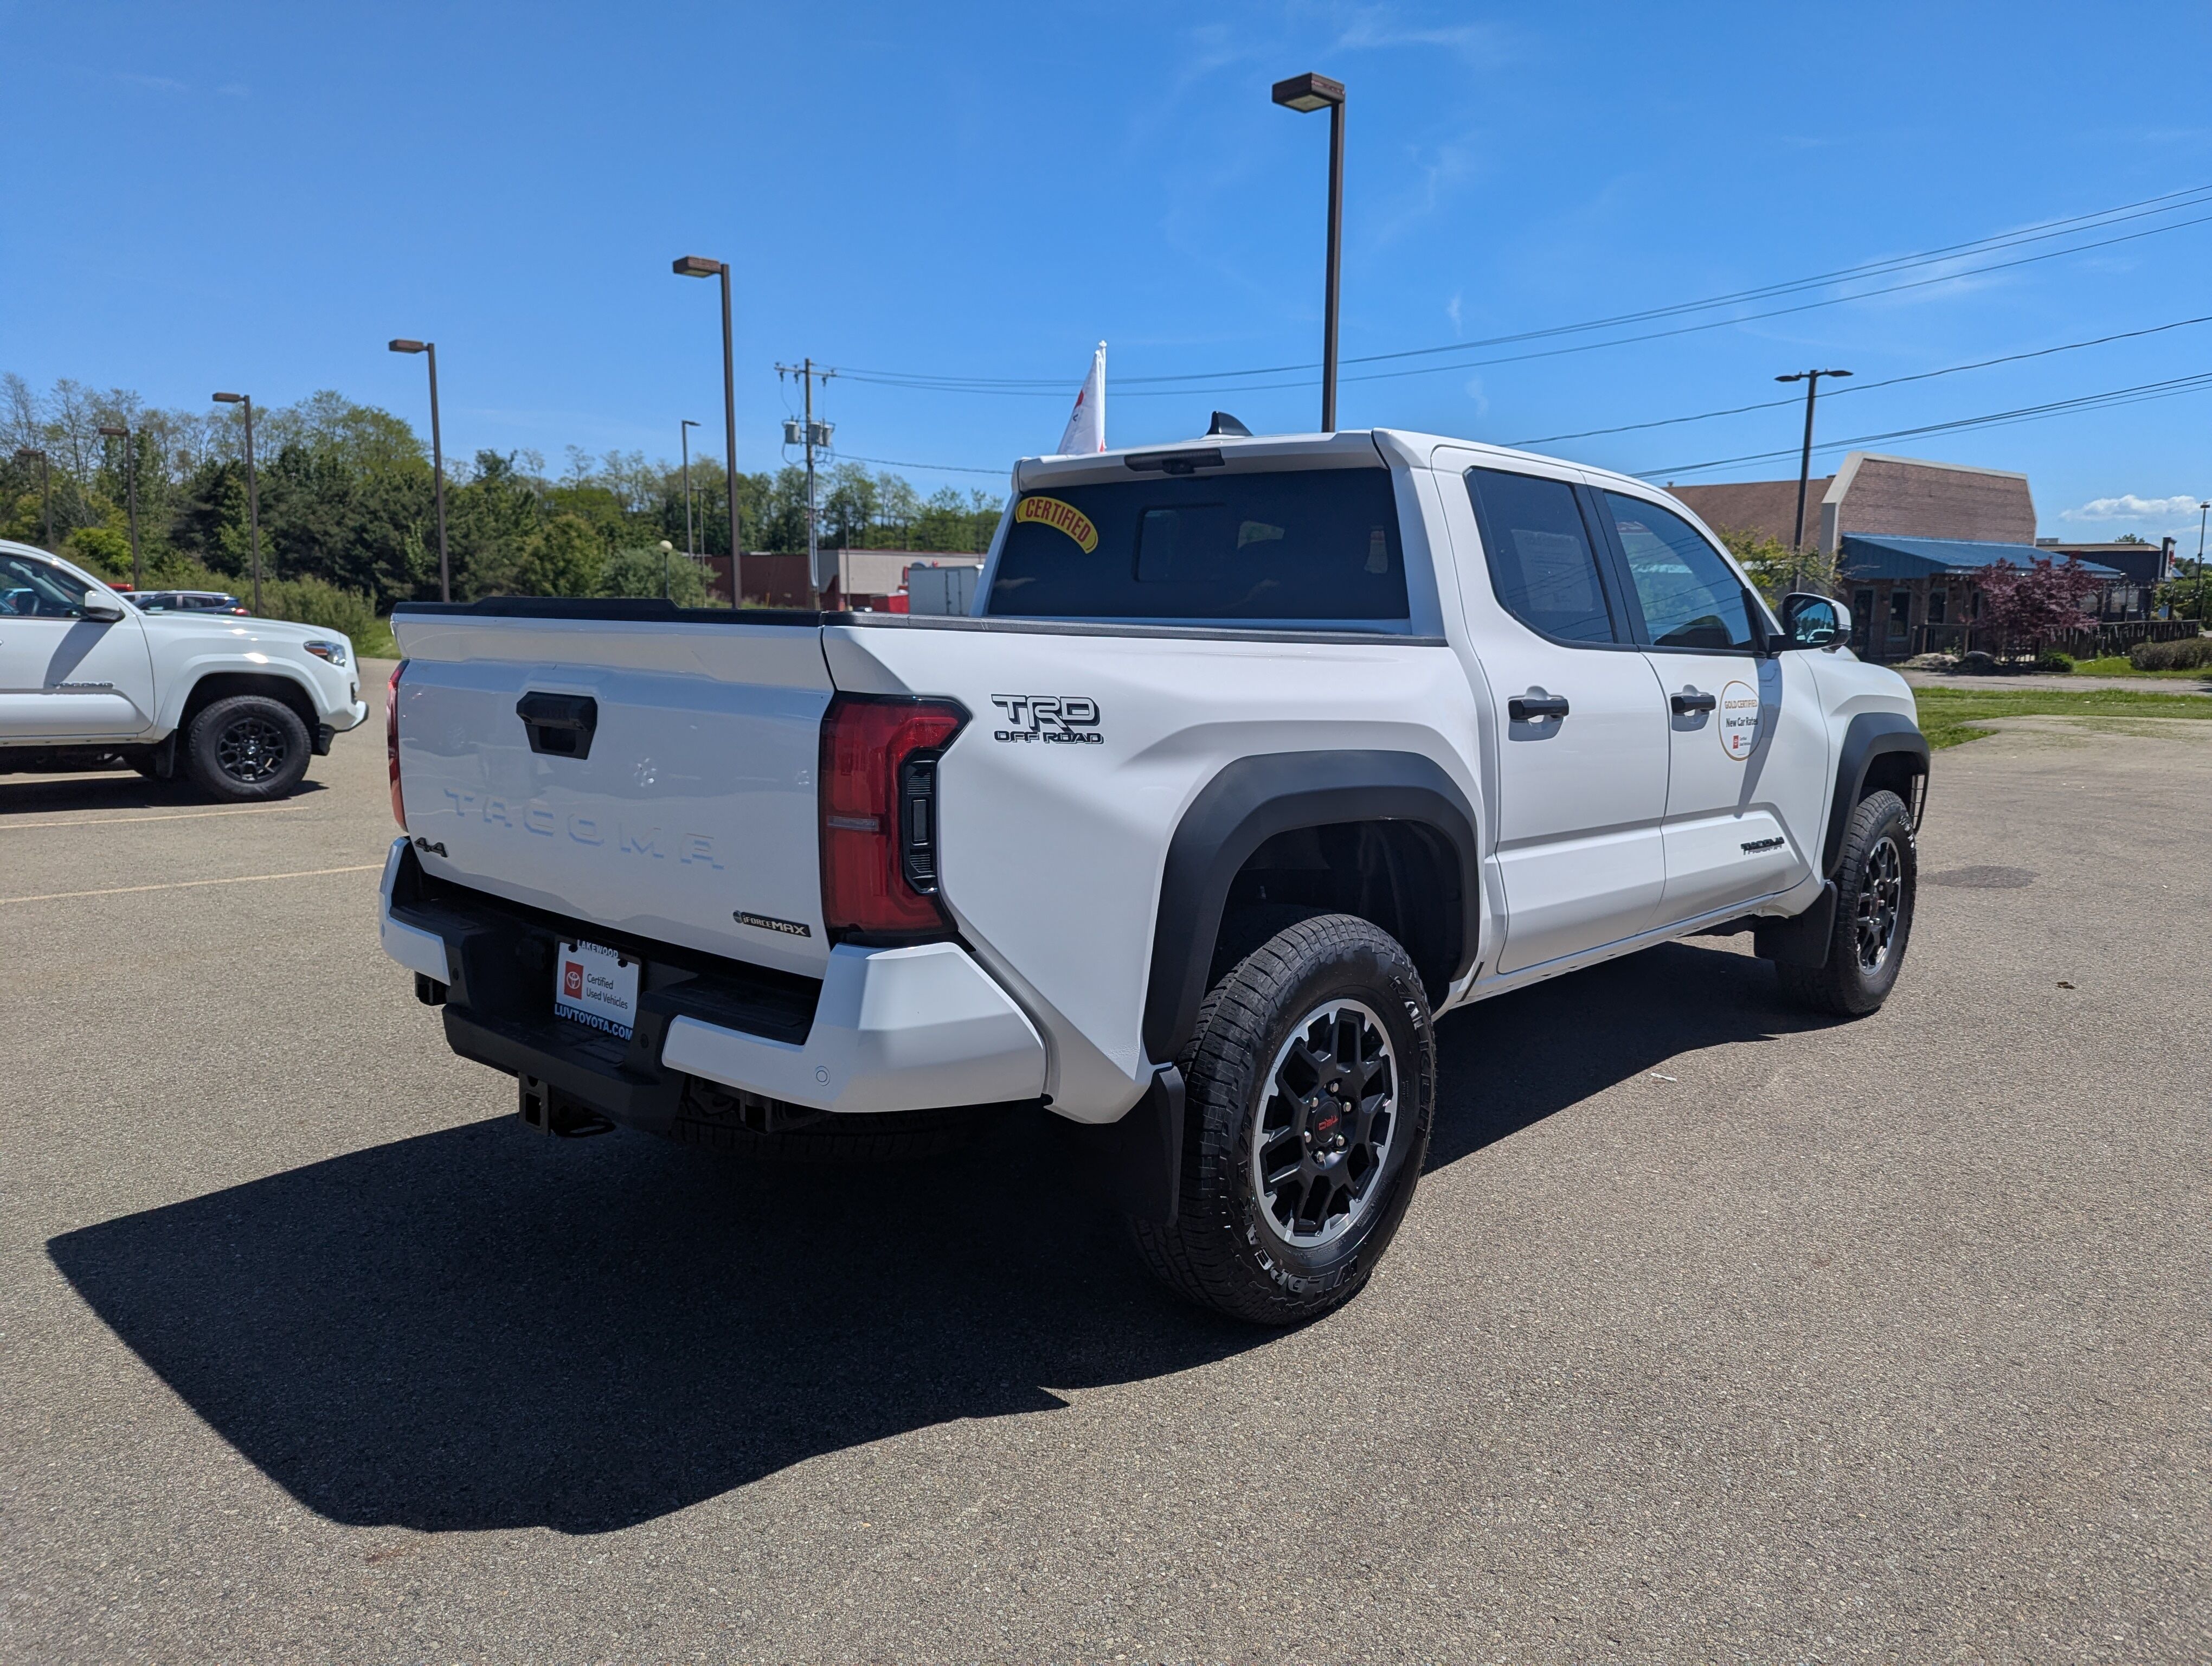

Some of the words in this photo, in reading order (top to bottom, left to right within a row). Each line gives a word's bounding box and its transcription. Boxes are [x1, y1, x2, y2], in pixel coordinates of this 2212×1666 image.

[1025, 499, 1091, 543] CERTIFIED
[991, 694, 1100, 733] TRD
[1725, 700, 1737, 709] GOLD
[1737, 700, 1757, 708] CERTIFIED
[1726, 717, 1737, 728] New
[1737, 717, 1745, 727] Car
[1746, 716, 1759, 726] Rates
[994, 731, 1040, 743] OFF
[1043, 732, 1104, 745] ROAD
[443, 787, 725, 870] TACOMA
[577, 939, 619, 958] LAKEWOOD
[587, 973, 614, 990] Certified
[586, 987, 602, 1001] Used
[602, 992, 628, 1010] Vehicles
[554, 1003, 634, 1041] LUVTOYOTA.COM
